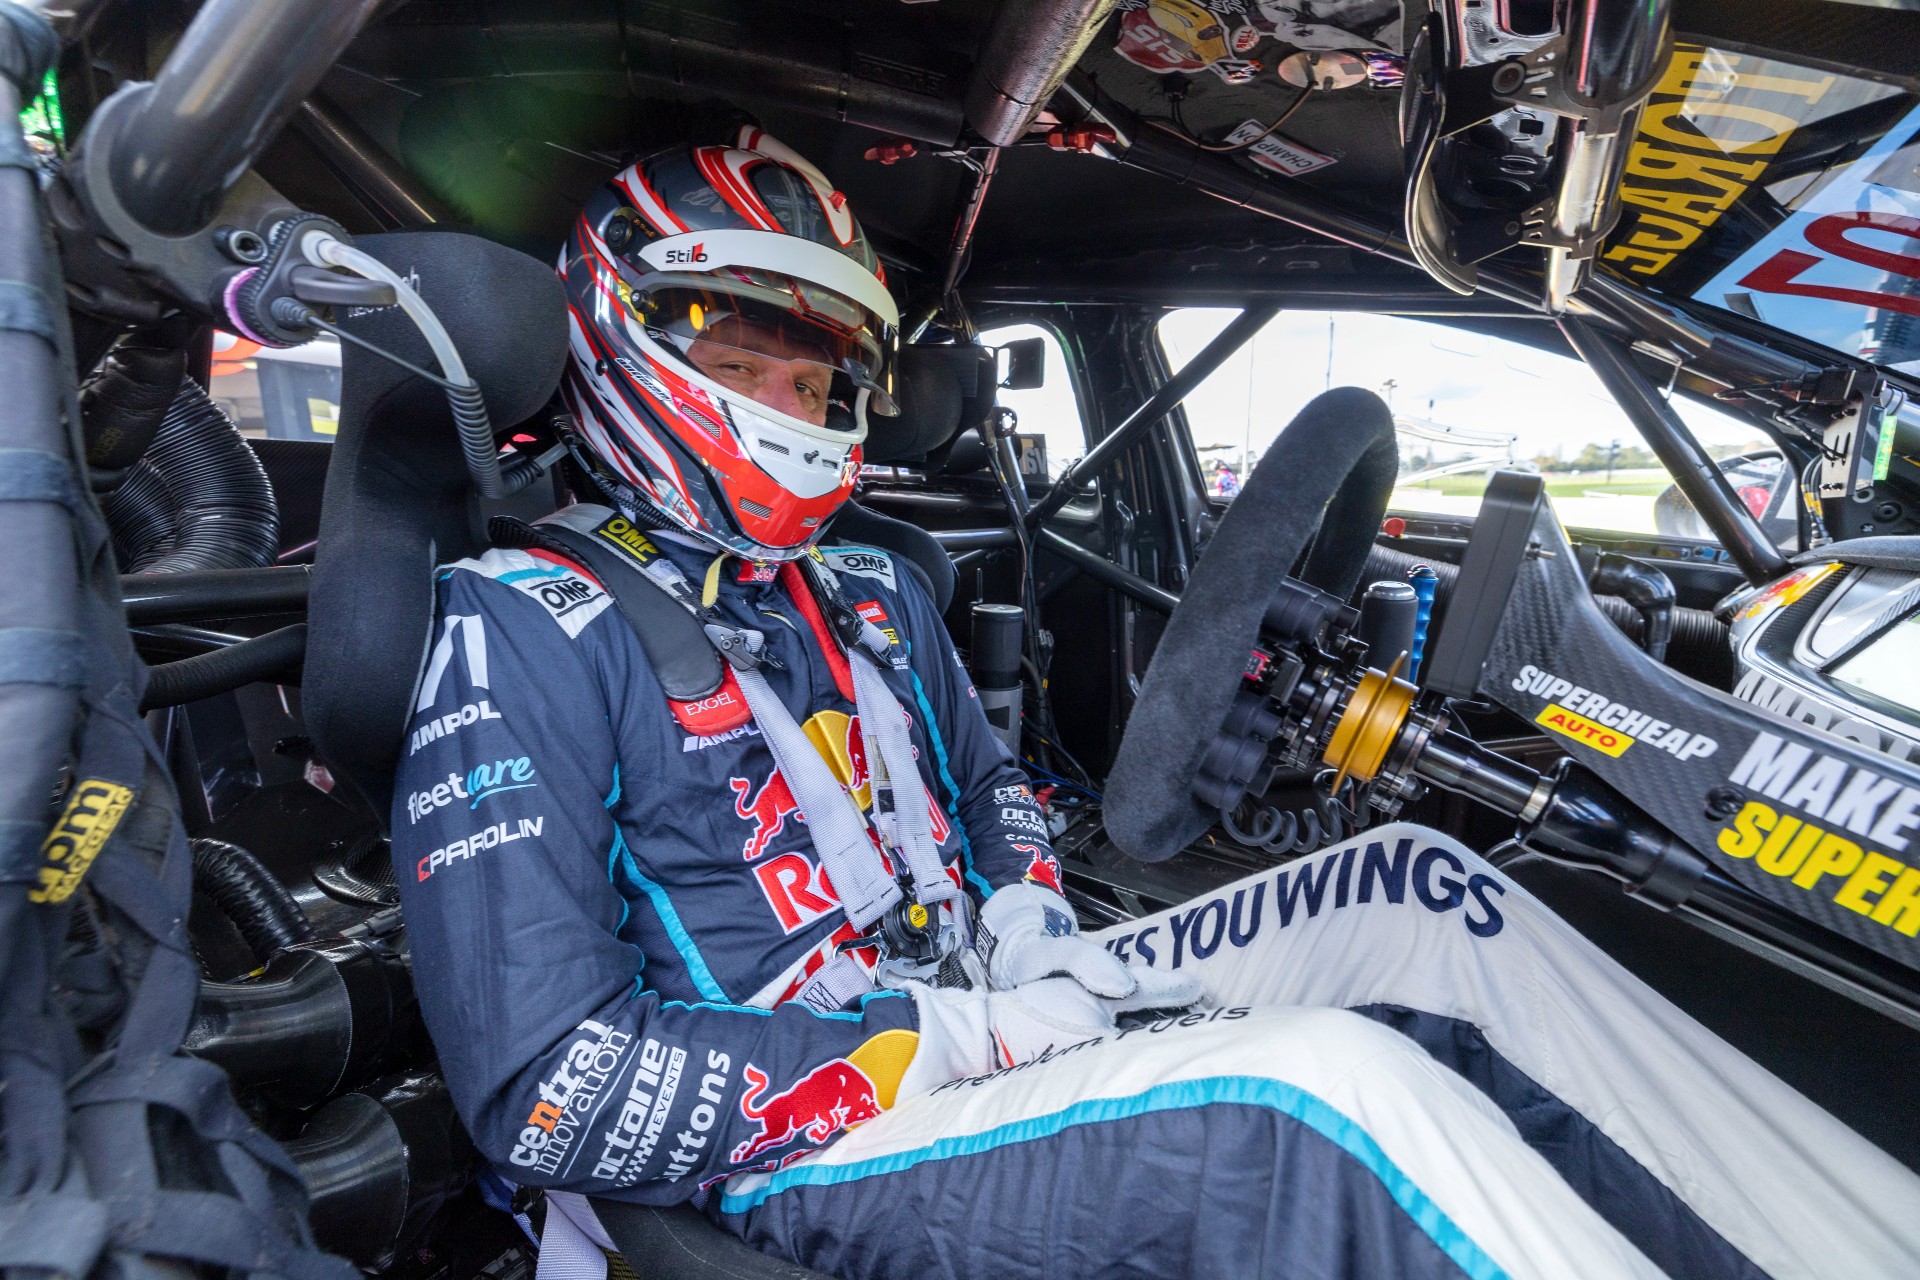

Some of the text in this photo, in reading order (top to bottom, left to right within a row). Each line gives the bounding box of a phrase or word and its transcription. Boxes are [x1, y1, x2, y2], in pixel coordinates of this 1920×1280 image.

[665, 242, 708, 264] Stilo
[541, 580, 590, 610] OMP
[843, 556, 888, 571] OMP
[410, 700, 502, 757] AMPOL
[684, 692, 737, 716] EXGEL
[1511, 664, 1719, 762] SUPERCHEAP
[1546, 713, 1619, 749] AUTO
[1728, 731, 1920, 852] MAKE
[1170, 882, 1263, 969] YOU
[1276, 838, 1506, 939] WINGS
[1716, 801, 1920, 938] SUPER
[510, 1019, 615, 1169] central
[533, 1028, 632, 1177] innovation
[591, 1038, 670, 1180] octane
[653, 1050, 684, 1126] EVENTS
[662, 1049, 731, 1183] uttons
